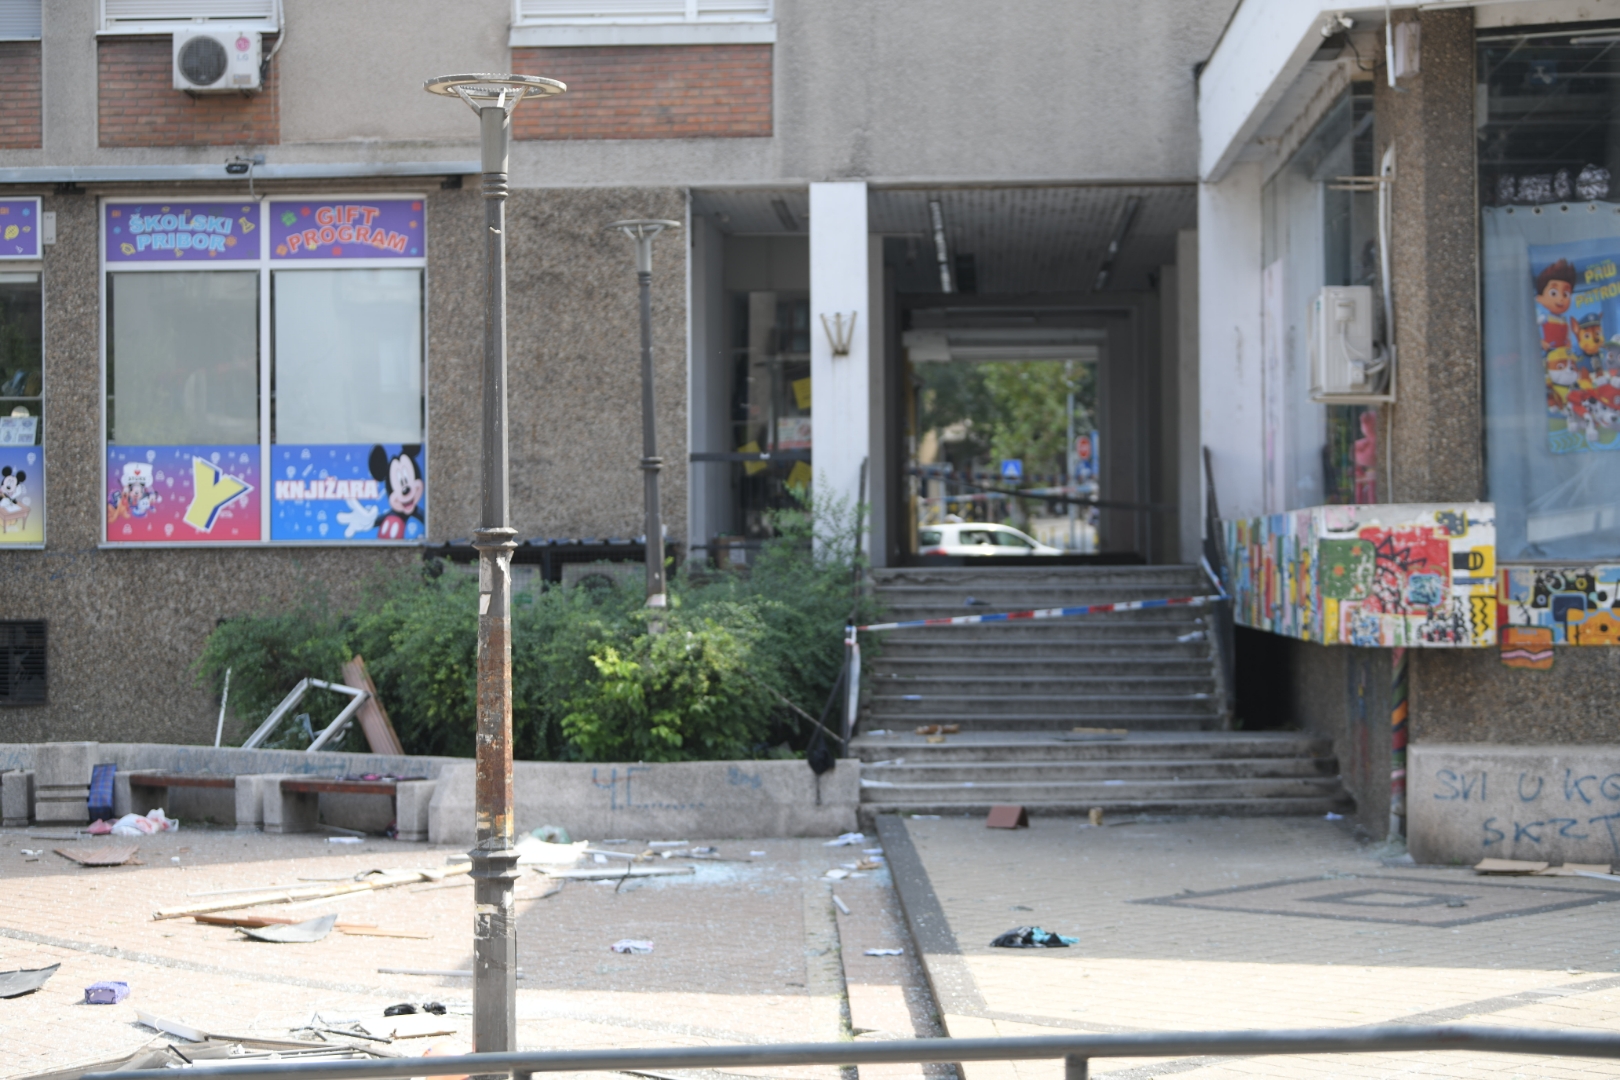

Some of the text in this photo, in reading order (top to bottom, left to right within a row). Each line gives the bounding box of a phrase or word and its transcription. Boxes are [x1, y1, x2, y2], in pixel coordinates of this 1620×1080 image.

[129, 213, 233, 235] ŠKOLSKI
[316, 205, 379, 226] GIFT
[136, 232, 226, 252] PRIBOR
[286, 225, 408, 254] PROGRAM
[1584, 262, 1617, 284] PAW
[275, 475, 379, 500] KNJIŽARA
[1433, 769, 1488, 801] SVI
[1518, 772, 1544, 802] U
